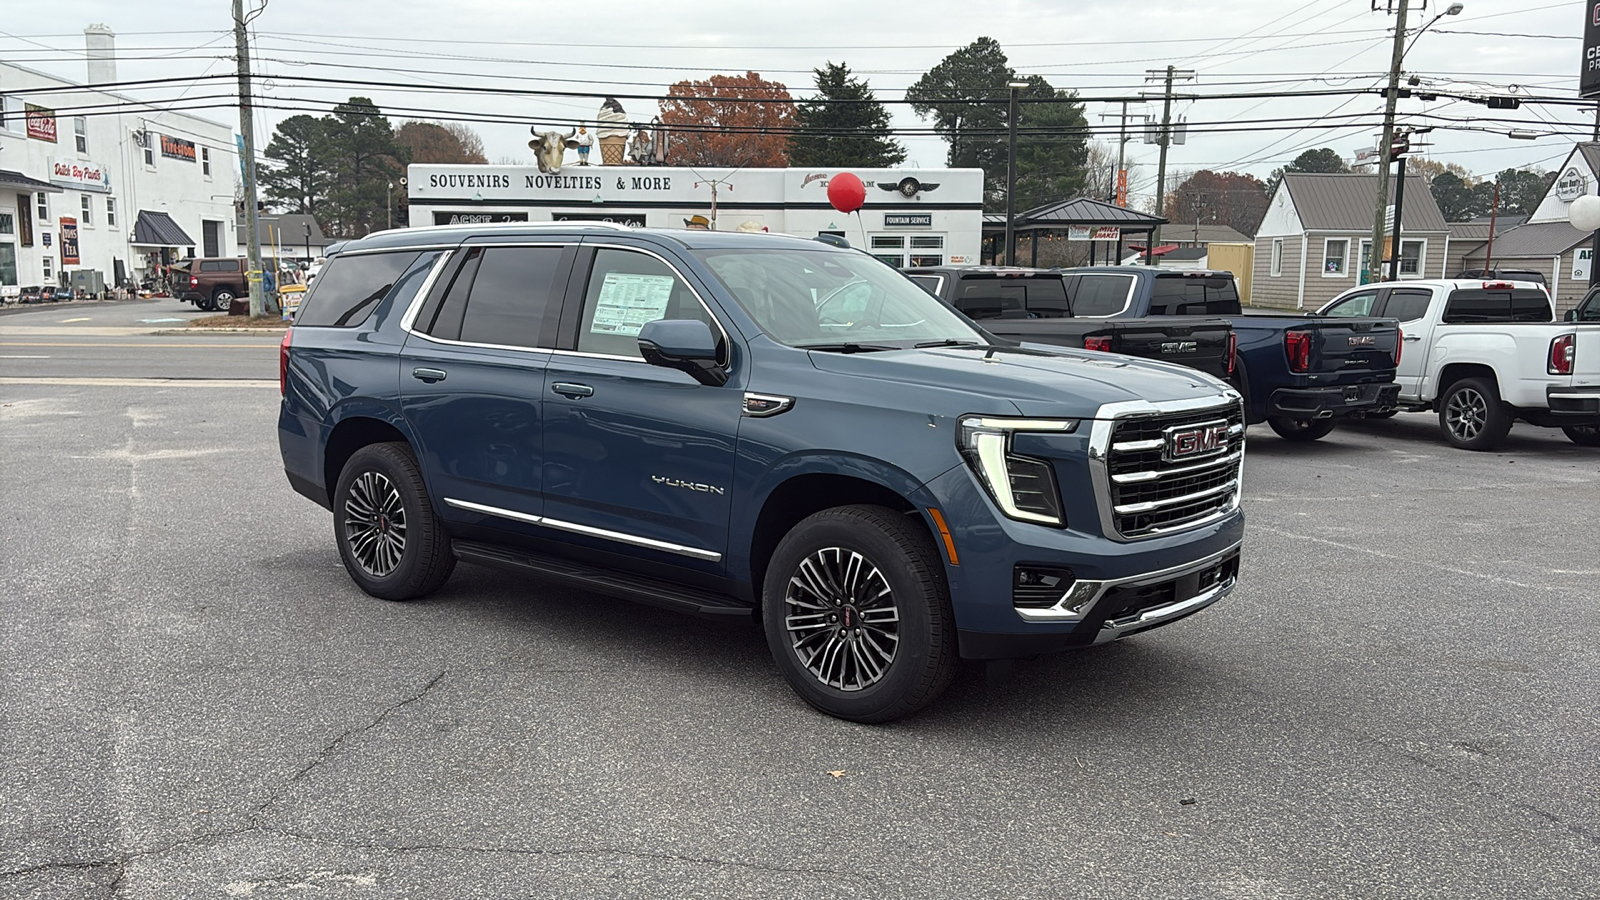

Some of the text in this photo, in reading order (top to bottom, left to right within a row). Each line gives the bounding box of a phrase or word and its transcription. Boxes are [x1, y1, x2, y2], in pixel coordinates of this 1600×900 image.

[161, 136, 196, 158] Firestone
[54, 162, 101, 181] Dutch Boy Paints
[430, 174, 671, 190] SOUVENIRS NOVELTIES & MORE
[886, 216, 930, 224] FOUNTAIN SERVICE
[65, 243, 77, 256] TEA
[1162, 341, 1197, 354] GMC
[1348, 336, 1375, 346] GMC
[749, 399, 767, 408] GMC
[1174, 427, 1229, 456] GMC
[651, 475, 725, 496] YUKON
